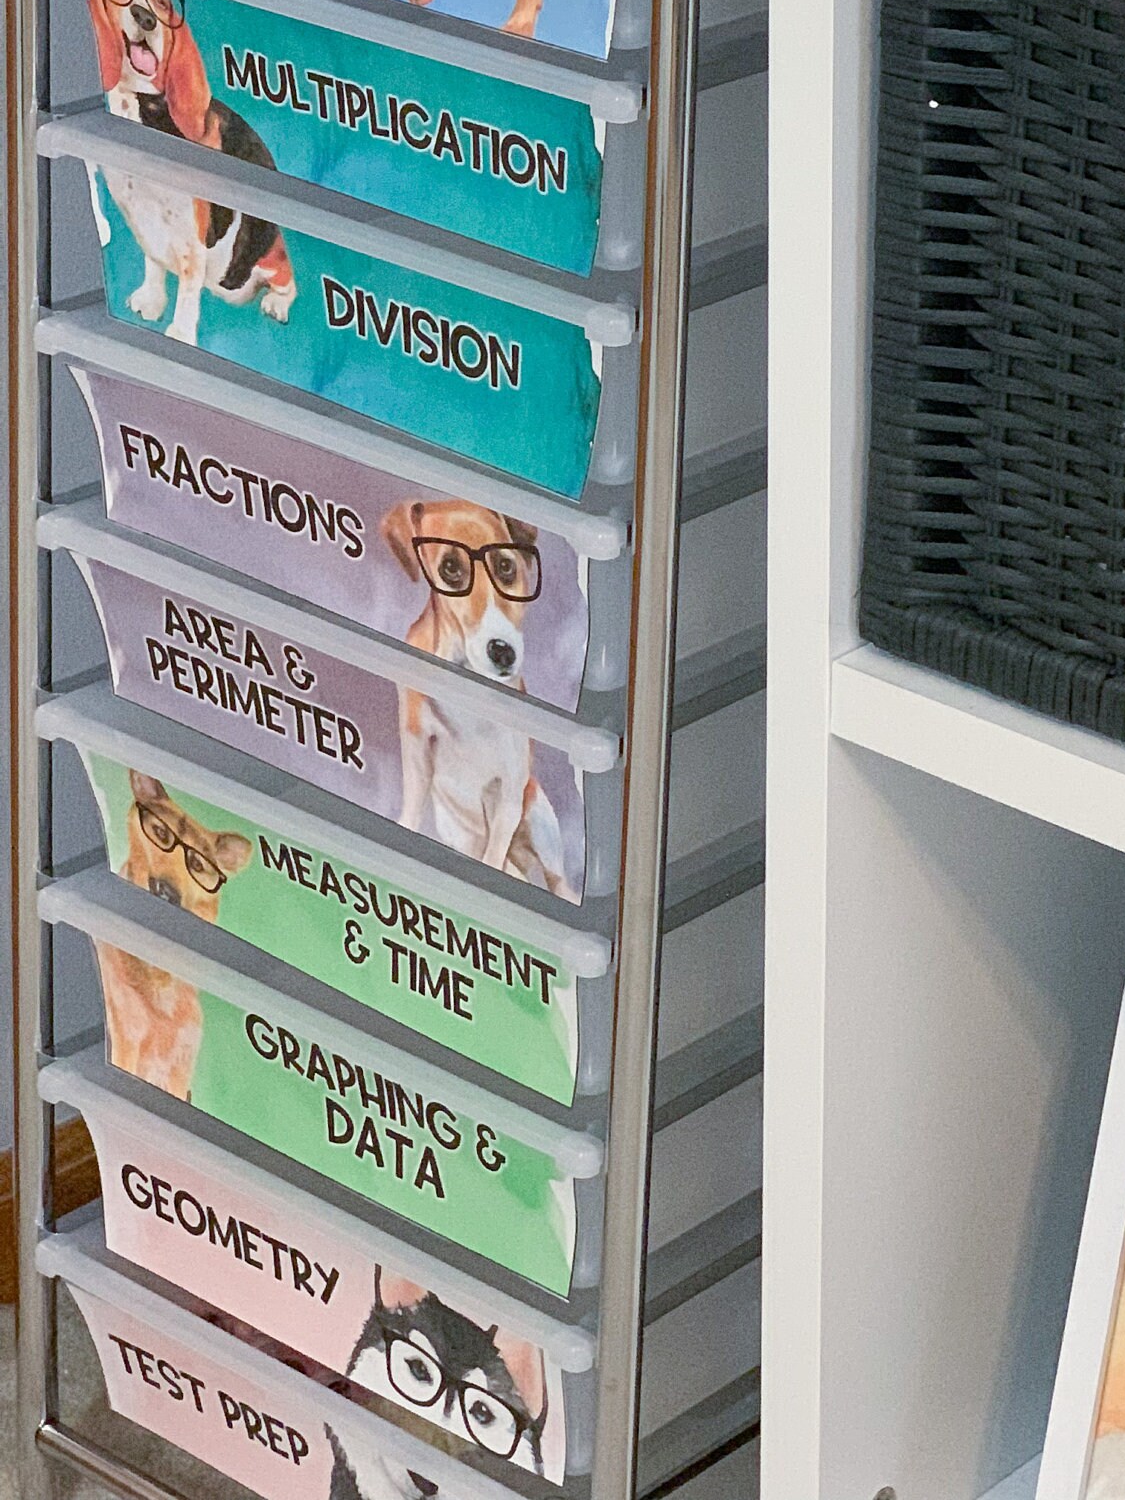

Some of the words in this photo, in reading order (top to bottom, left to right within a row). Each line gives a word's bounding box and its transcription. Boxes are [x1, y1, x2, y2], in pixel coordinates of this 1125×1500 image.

[223, 46, 568, 193] MULTIPLICATION
[322, 276, 520, 388] DIVISION
[119, 424, 364, 558] FRACTIONS
[145, 638, 364, 770] PERIMETER
[164, 599, 272, 674] AREA
[284, 644, 316, 691] &
[258, 836, 557, 1004] MEASUREMENT
[343, 920, 370, 964] &
[382, 937, 474, 1020] TIME
[244, 1013, 461, 1150] GRAPHING
[476, 1124, 506, 1172] &
[324, 1098, 446, 1198] DATA
[121, 1164, 340, 1304] GEOMETRY
[109, 1334, 205, 1412] TEST
[218, 1390, 309, 1466] PREP
